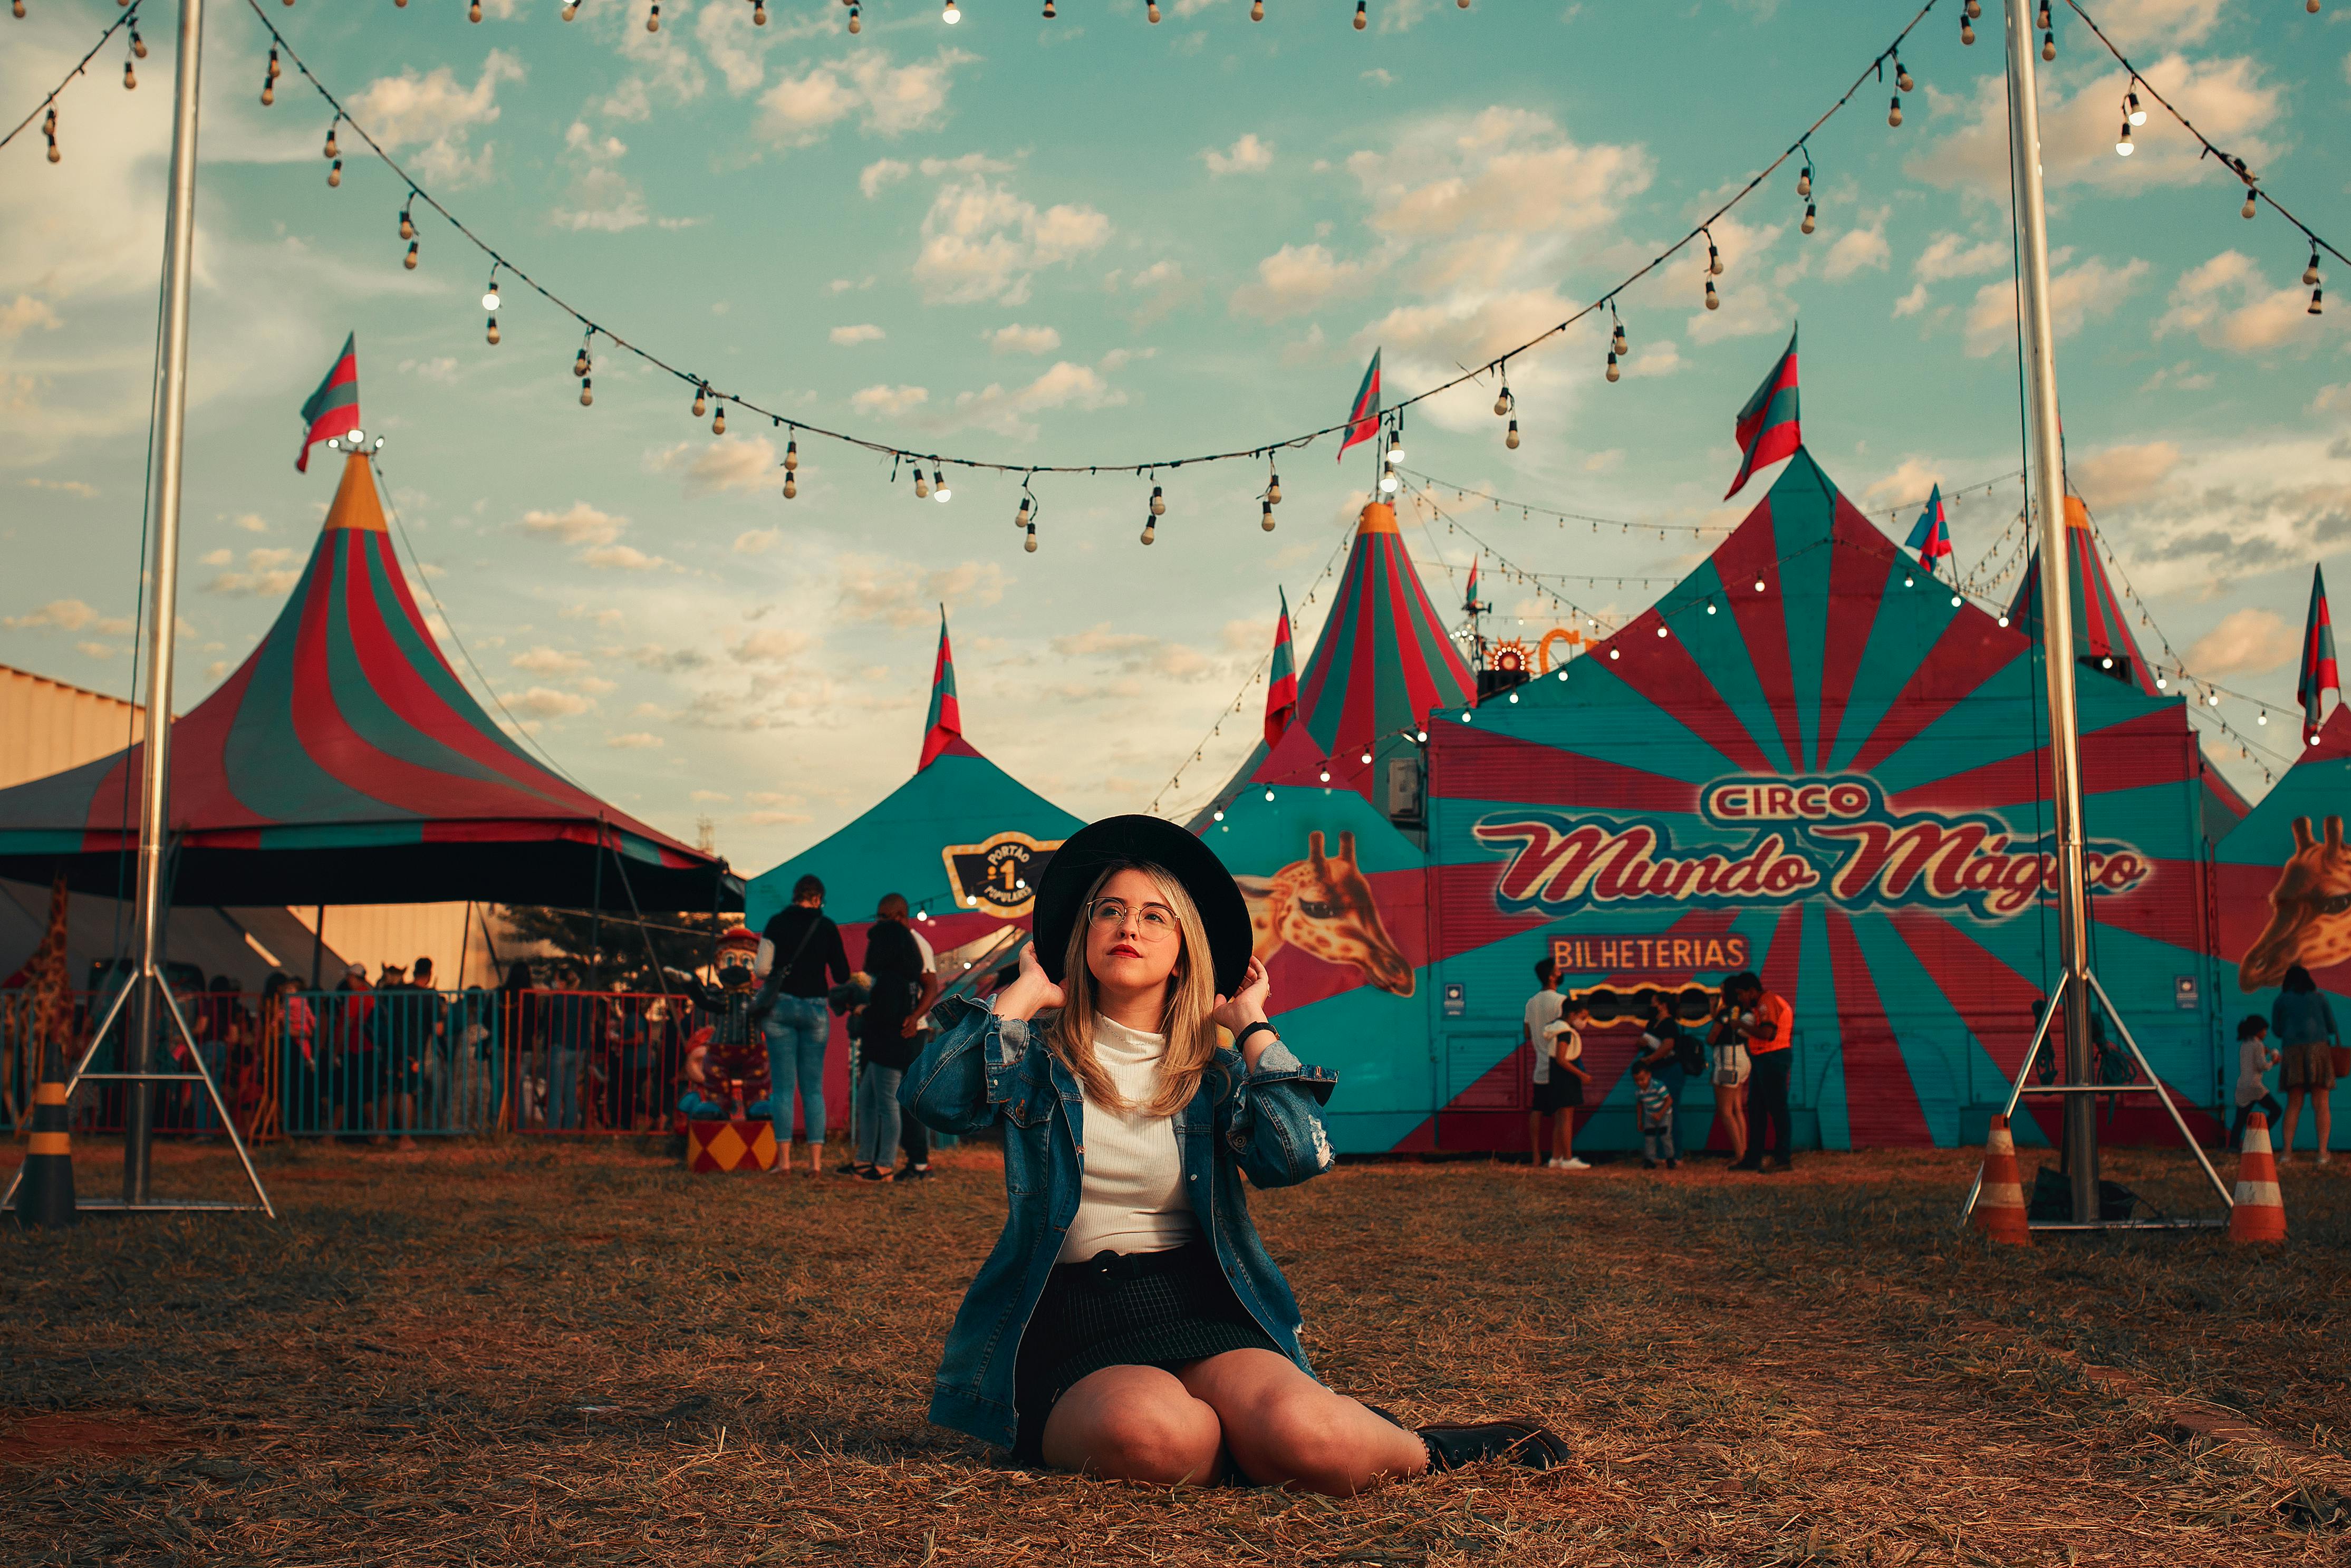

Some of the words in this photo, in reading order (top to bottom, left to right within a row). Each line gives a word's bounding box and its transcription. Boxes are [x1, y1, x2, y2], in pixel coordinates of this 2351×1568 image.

[1714, 784, 1870, 817] CIRCO
[987, 845, 1030, 865] PORTÃO
[1475, 823, 1818, 900] Mundo
[1809, 822, 2148, 912] Mágco
[1554, 938, 1744, 968] BILHETERIAS
